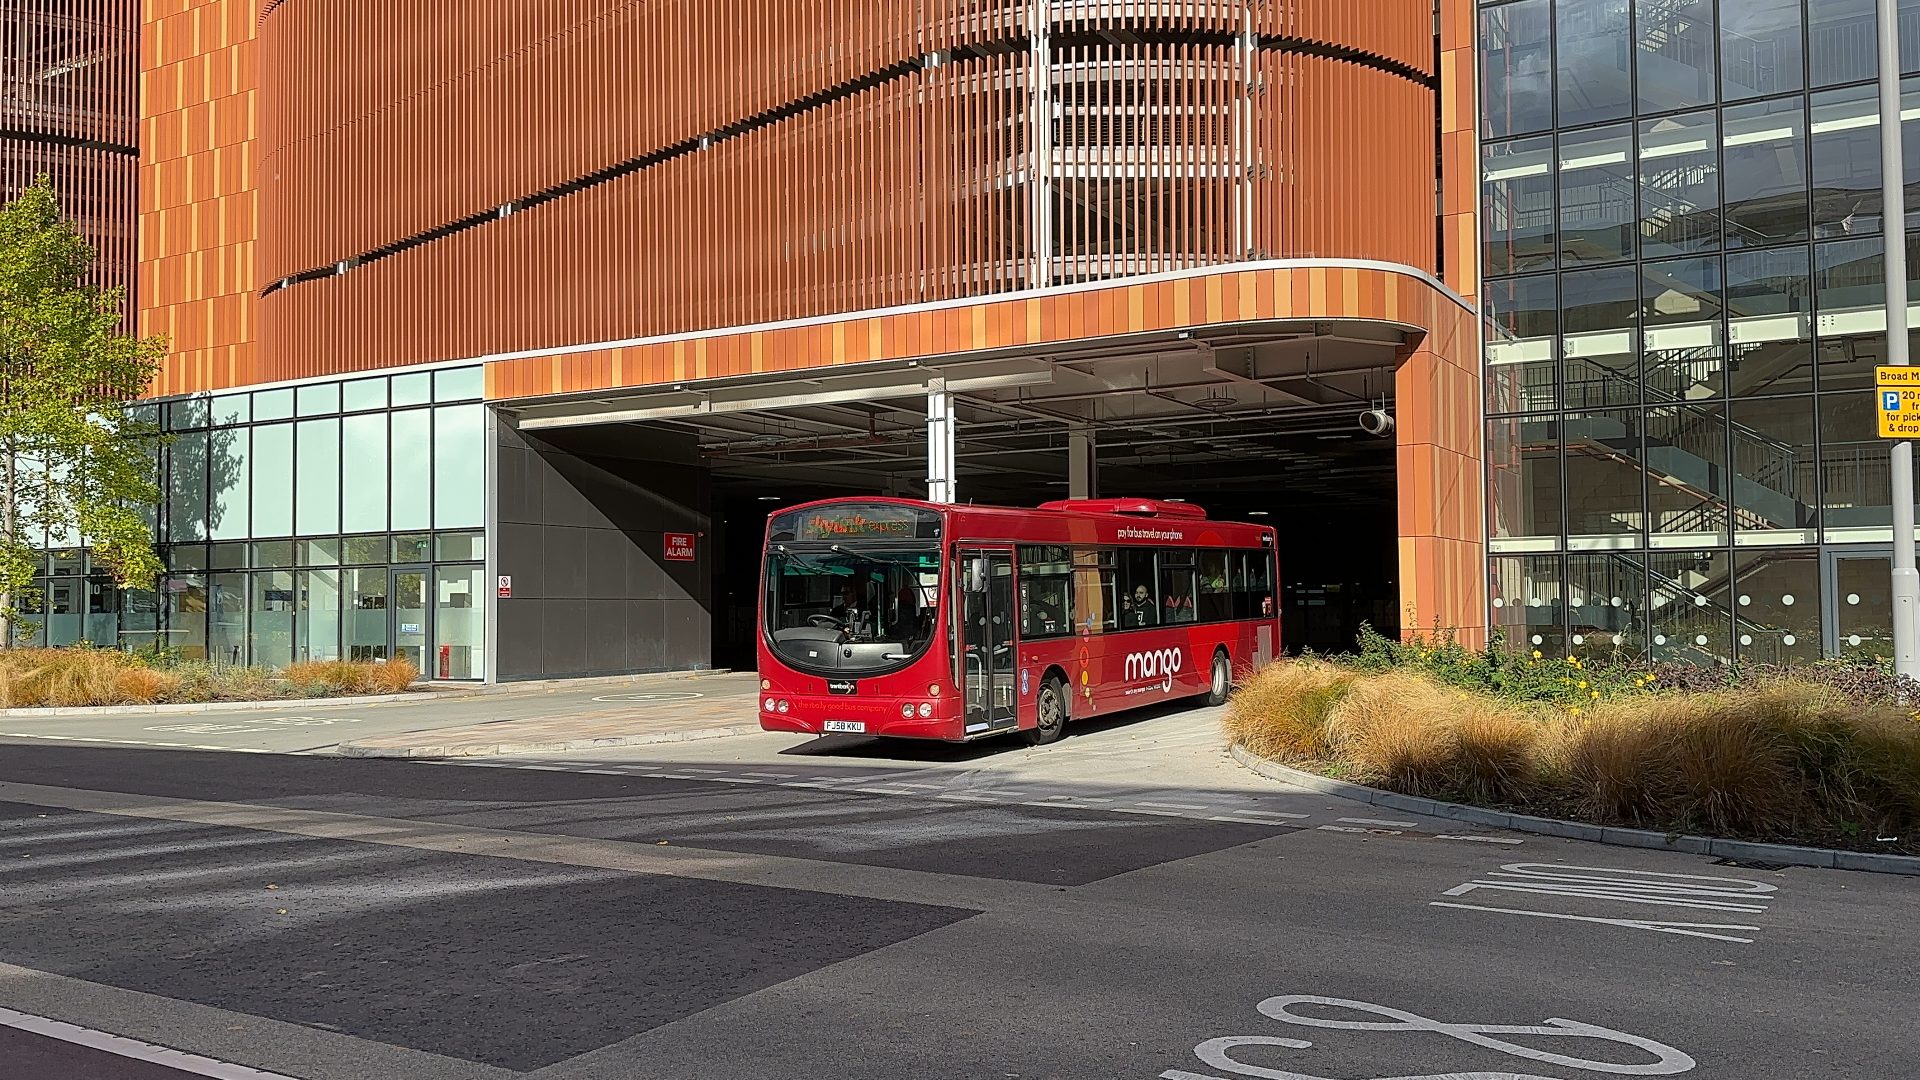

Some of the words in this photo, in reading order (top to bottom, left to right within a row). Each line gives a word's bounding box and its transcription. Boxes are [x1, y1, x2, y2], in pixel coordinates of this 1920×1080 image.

[1881, 372, 1908, 380] Broad
[1911, 372, 1920, 380] M
[1886, 393, 1897, 409] P
[1902, 391, 1916, 400] 20
[1912, 402, 1920, 410] fr
[1886, 413, 1899, 421] for
[1889, 424, 1895, 432] &
[1898, 424, 1919, 433] drop
[1117, 529, 1127, 540] pay
[1134, 526, 1142, 538] bus
[1142, 527, 1155, 539] travel
[1161, 531, 1170, 541] your
[1170, 528, 1183, 541] phone
[672, 536, 687, 546] FIRE
[666, 546, 693, 557] ALARM
[1124, 646, 1182, 693] mango
[799, 700, 809, 709] the
[827, 701, 844, 712] good
[844, 702, 856, 711] bus
[857, 705, 888, 714] company
[826, 721, 846, 731] FJ58
[847, 722, 862, 731] KKU
